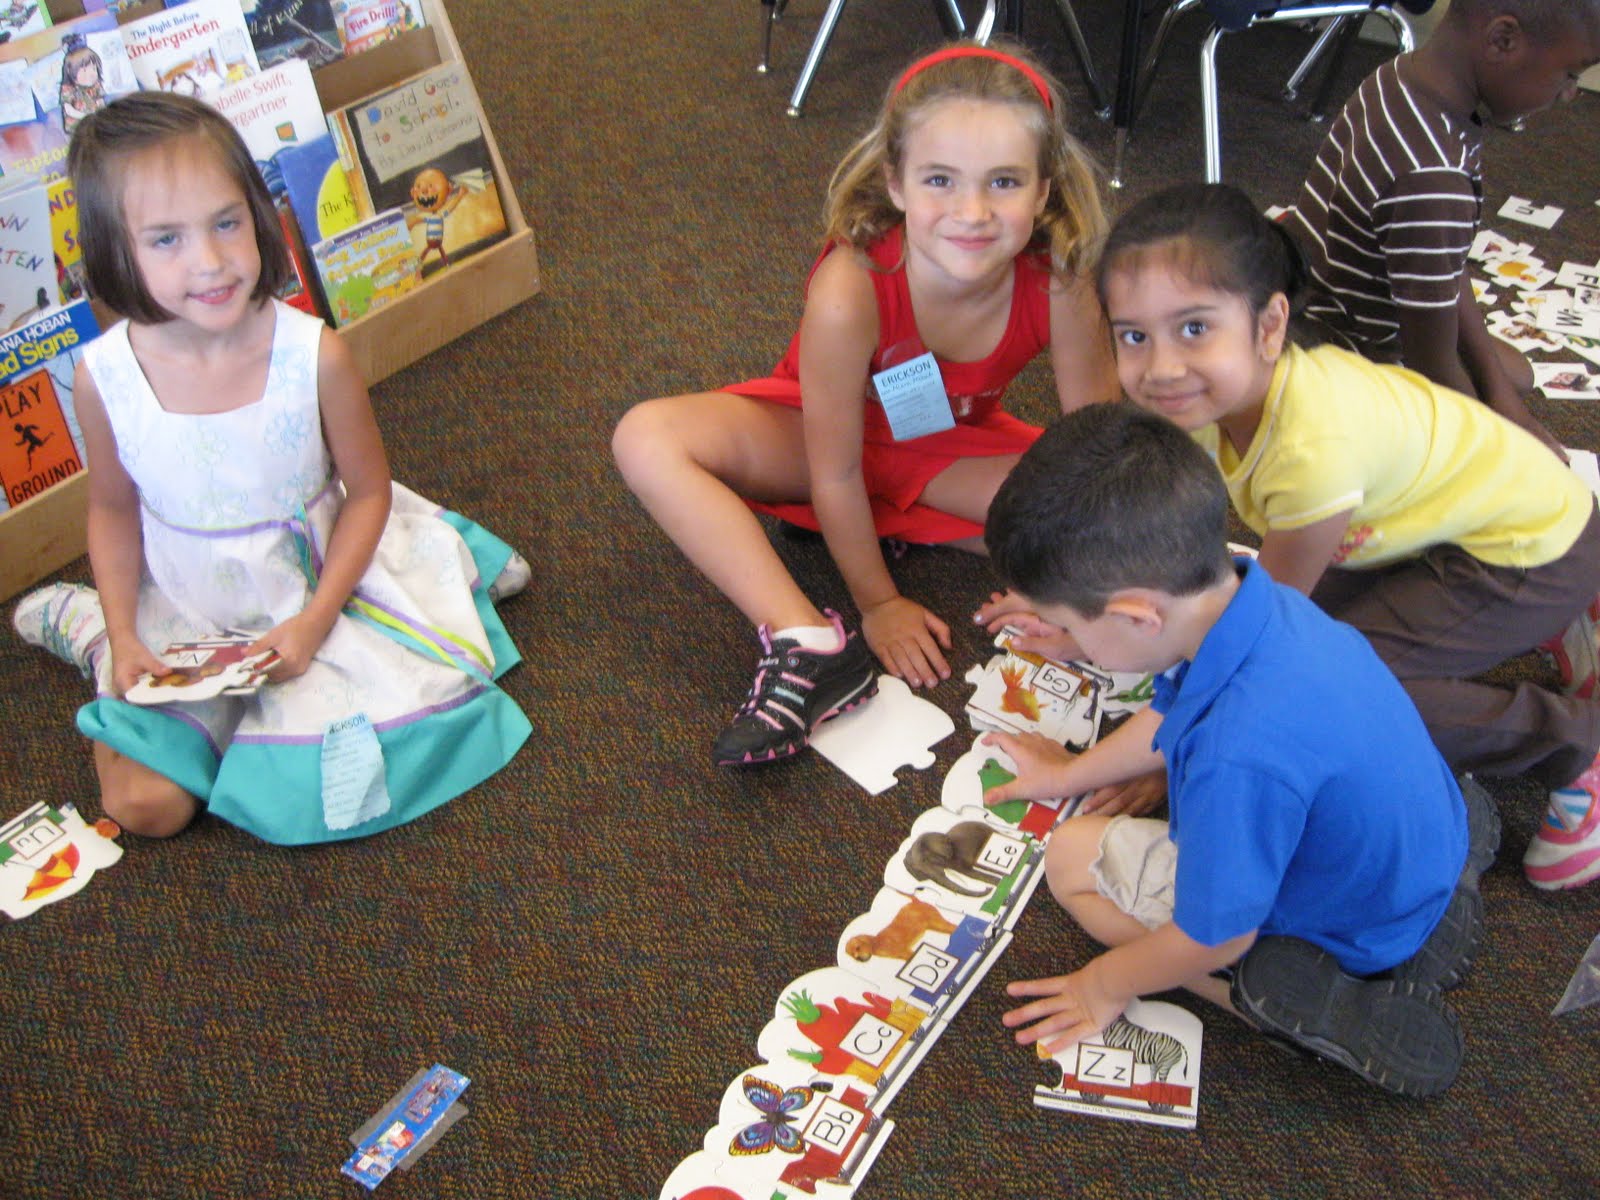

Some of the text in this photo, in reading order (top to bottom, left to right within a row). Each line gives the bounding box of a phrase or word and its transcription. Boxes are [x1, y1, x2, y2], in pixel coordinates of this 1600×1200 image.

[131, 12, 200, 41] The Night Before
[366, 86, 418, 127] David
[320, 200, 341, 218] The
[24, 310, 72, 341] HOBAN
[19, 328, 79, 366] Signs
[881, 361, 932, 387] ERICKSON
[0, 382, 42, 419] LAY
[11, 458, 78, 503] GROUND
[983, 843, 1017, 870] Ee
[909, 951, 950, 987] Dd
[853, 1025, 892, 1056] Cc
[1083, 1050, 1127, 1081] Zz
[812, 1110, 855, 1146] Bb
